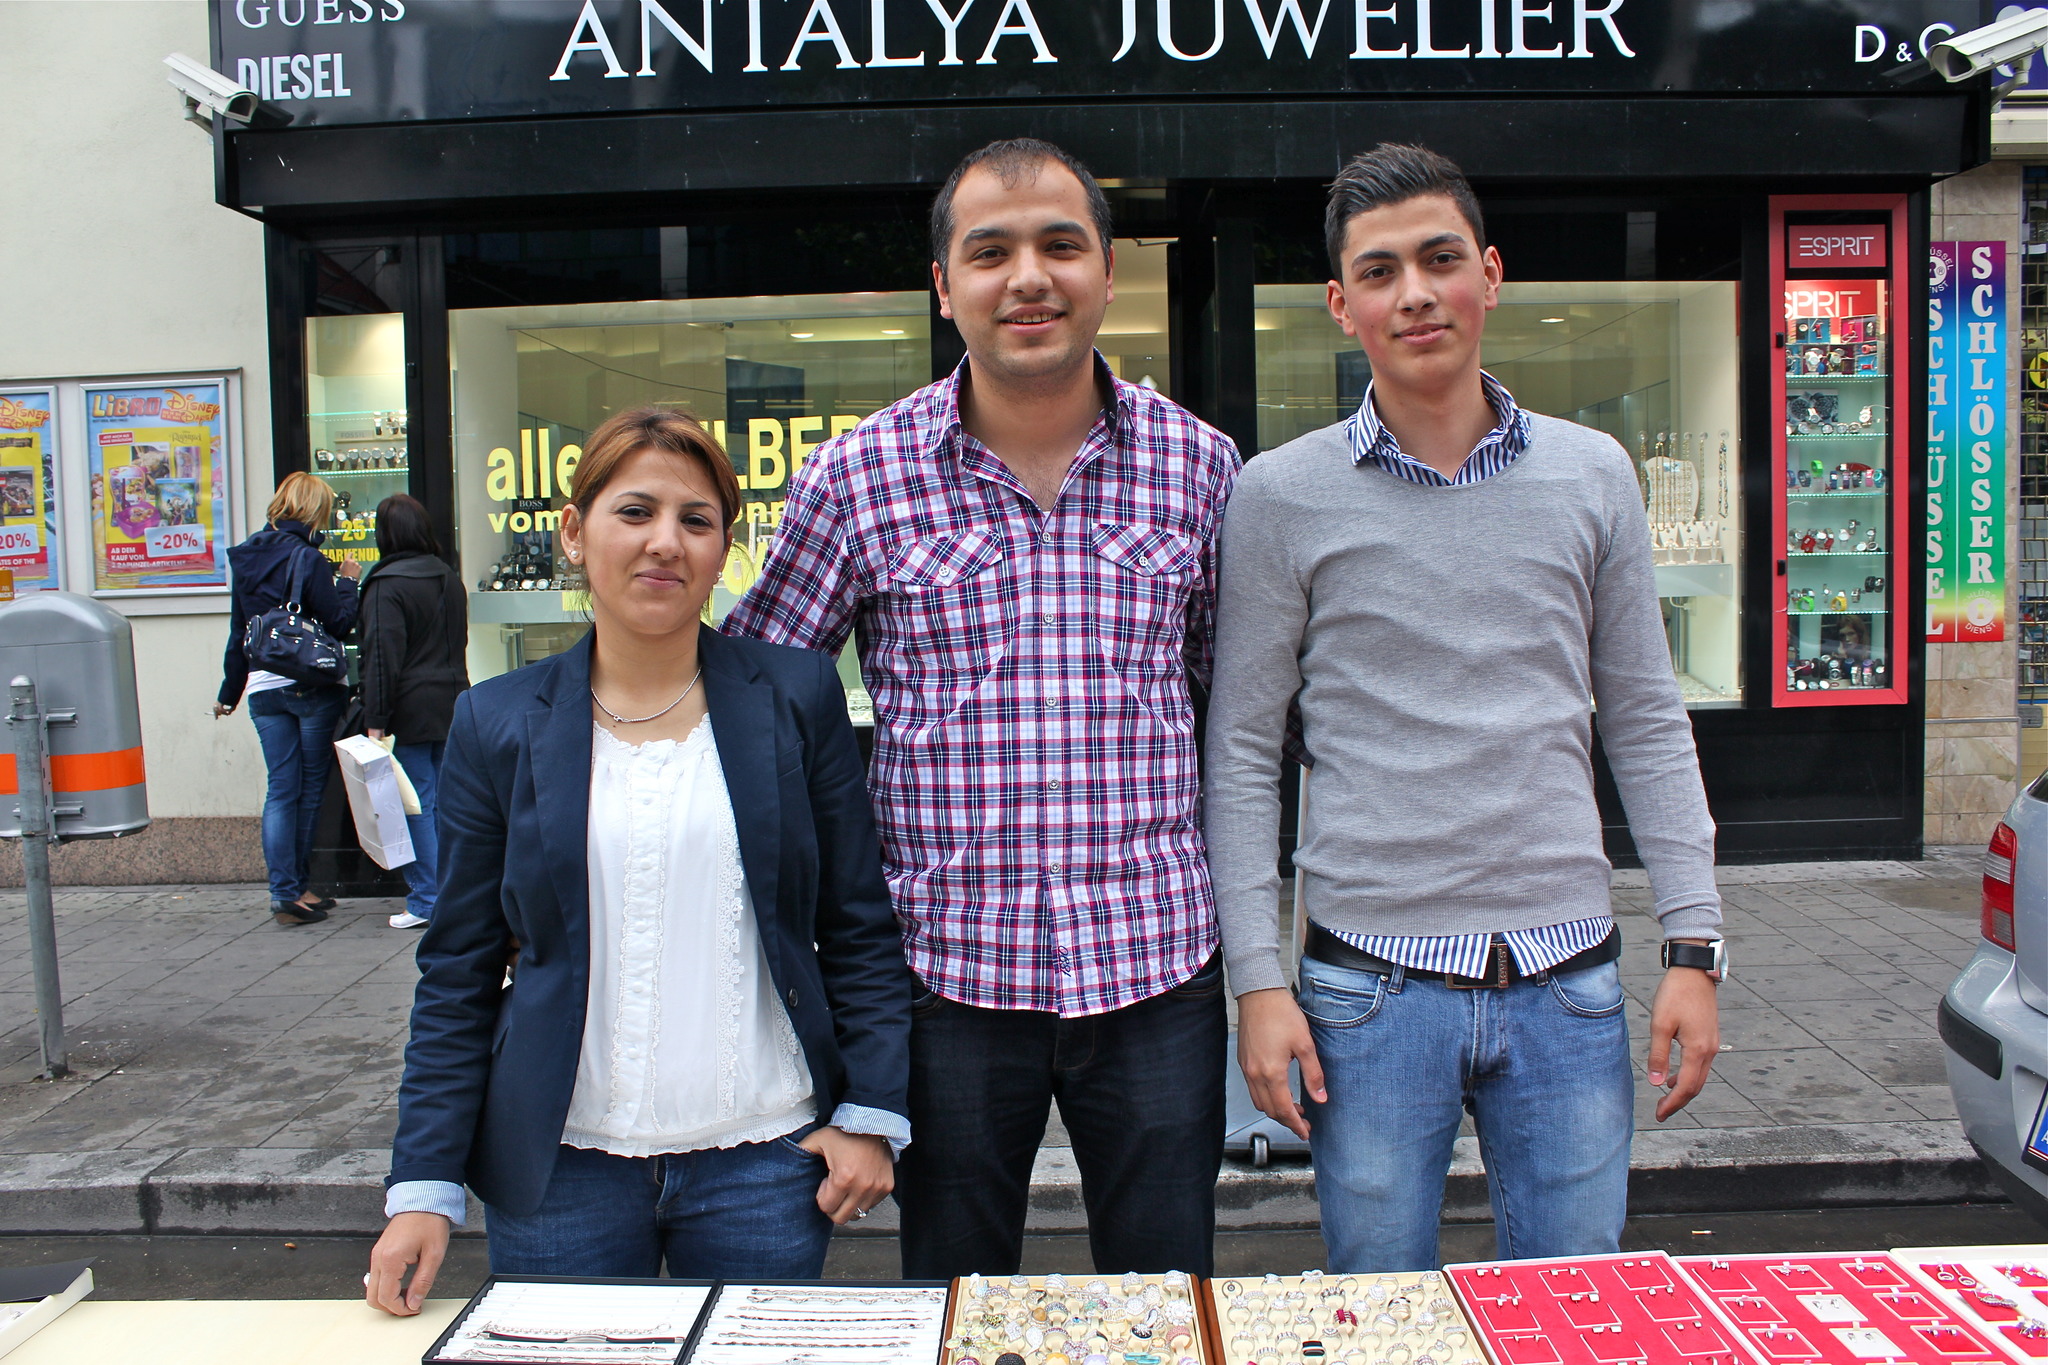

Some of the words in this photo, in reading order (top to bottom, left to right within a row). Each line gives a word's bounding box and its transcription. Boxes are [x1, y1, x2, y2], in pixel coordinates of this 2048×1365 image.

[236, 0, 406, 28] GUESS
[549, 0, 1058, 81] ANTALYA
[1111, 0, 1636, 62] JUWELIER
[1854, 24, 1887, 63] D
[1895, 42, 1913, 62] &
[237, 53, 351, 101] DIESEL
[1799, 236, 1875, 257] ESPRIT
[1966, 247, 1998, 584] SCHLÖSSER
[486, 427, 582, 502] alle
[488, 510, 563, 533] vom
[154, 532, 198, 549] -20%
[1965, 621, 1997, 634] DIENST
